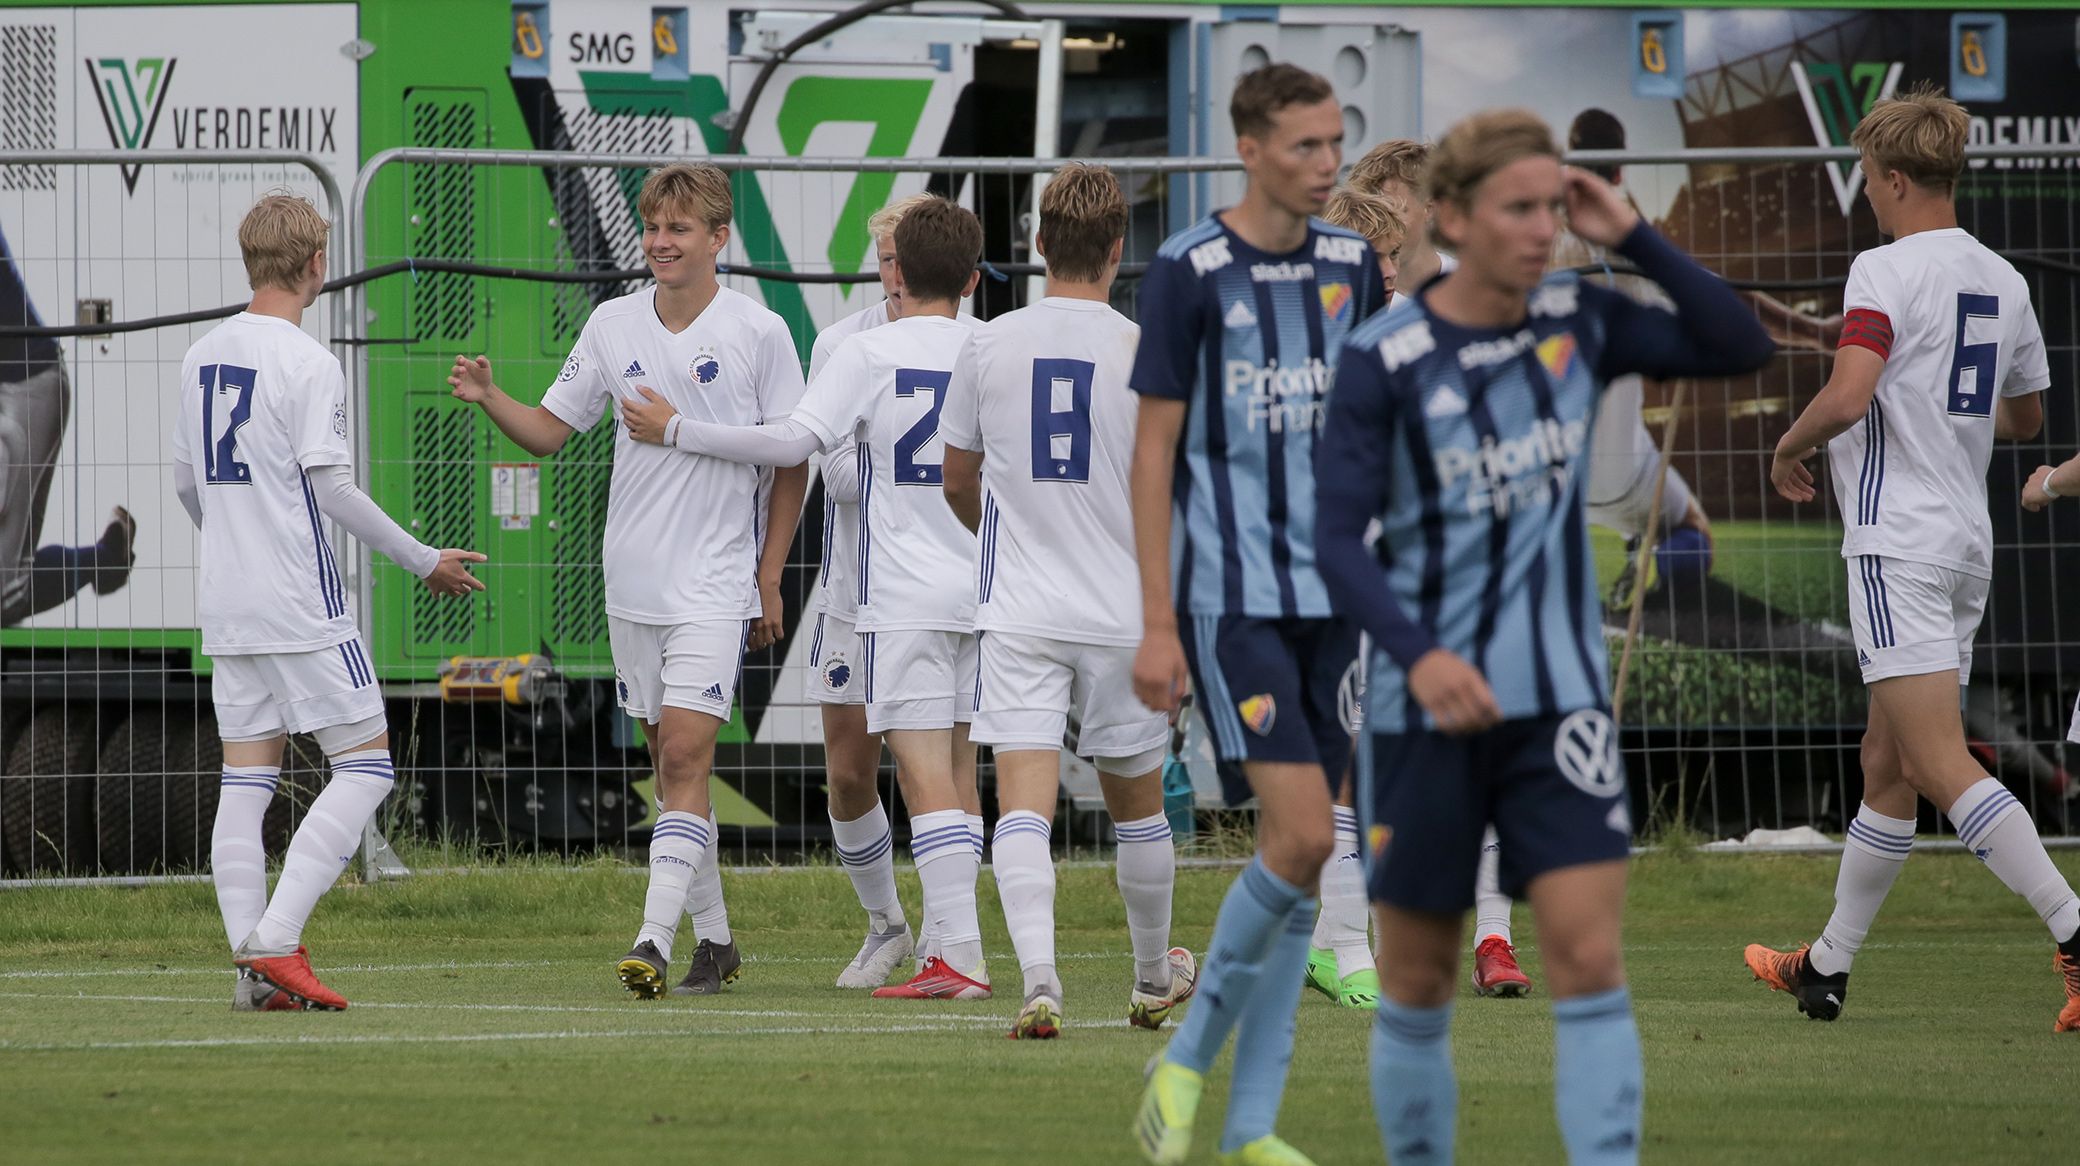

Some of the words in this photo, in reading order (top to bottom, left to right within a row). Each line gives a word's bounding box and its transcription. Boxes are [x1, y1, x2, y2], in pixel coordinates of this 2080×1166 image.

[570, 32, 635, 64] SMG
[173, 107, 337, 153] VERDEMIX
[1967, 115, 2080, 170] DEMIX
[172, 168, 214, 183] hybrid
[1947, 292, 1999, 418] 6
[894, 368, 952, 486] 2
[1031, 357, 1095, 484] 8
[701, 691, 724, 701] adidas
